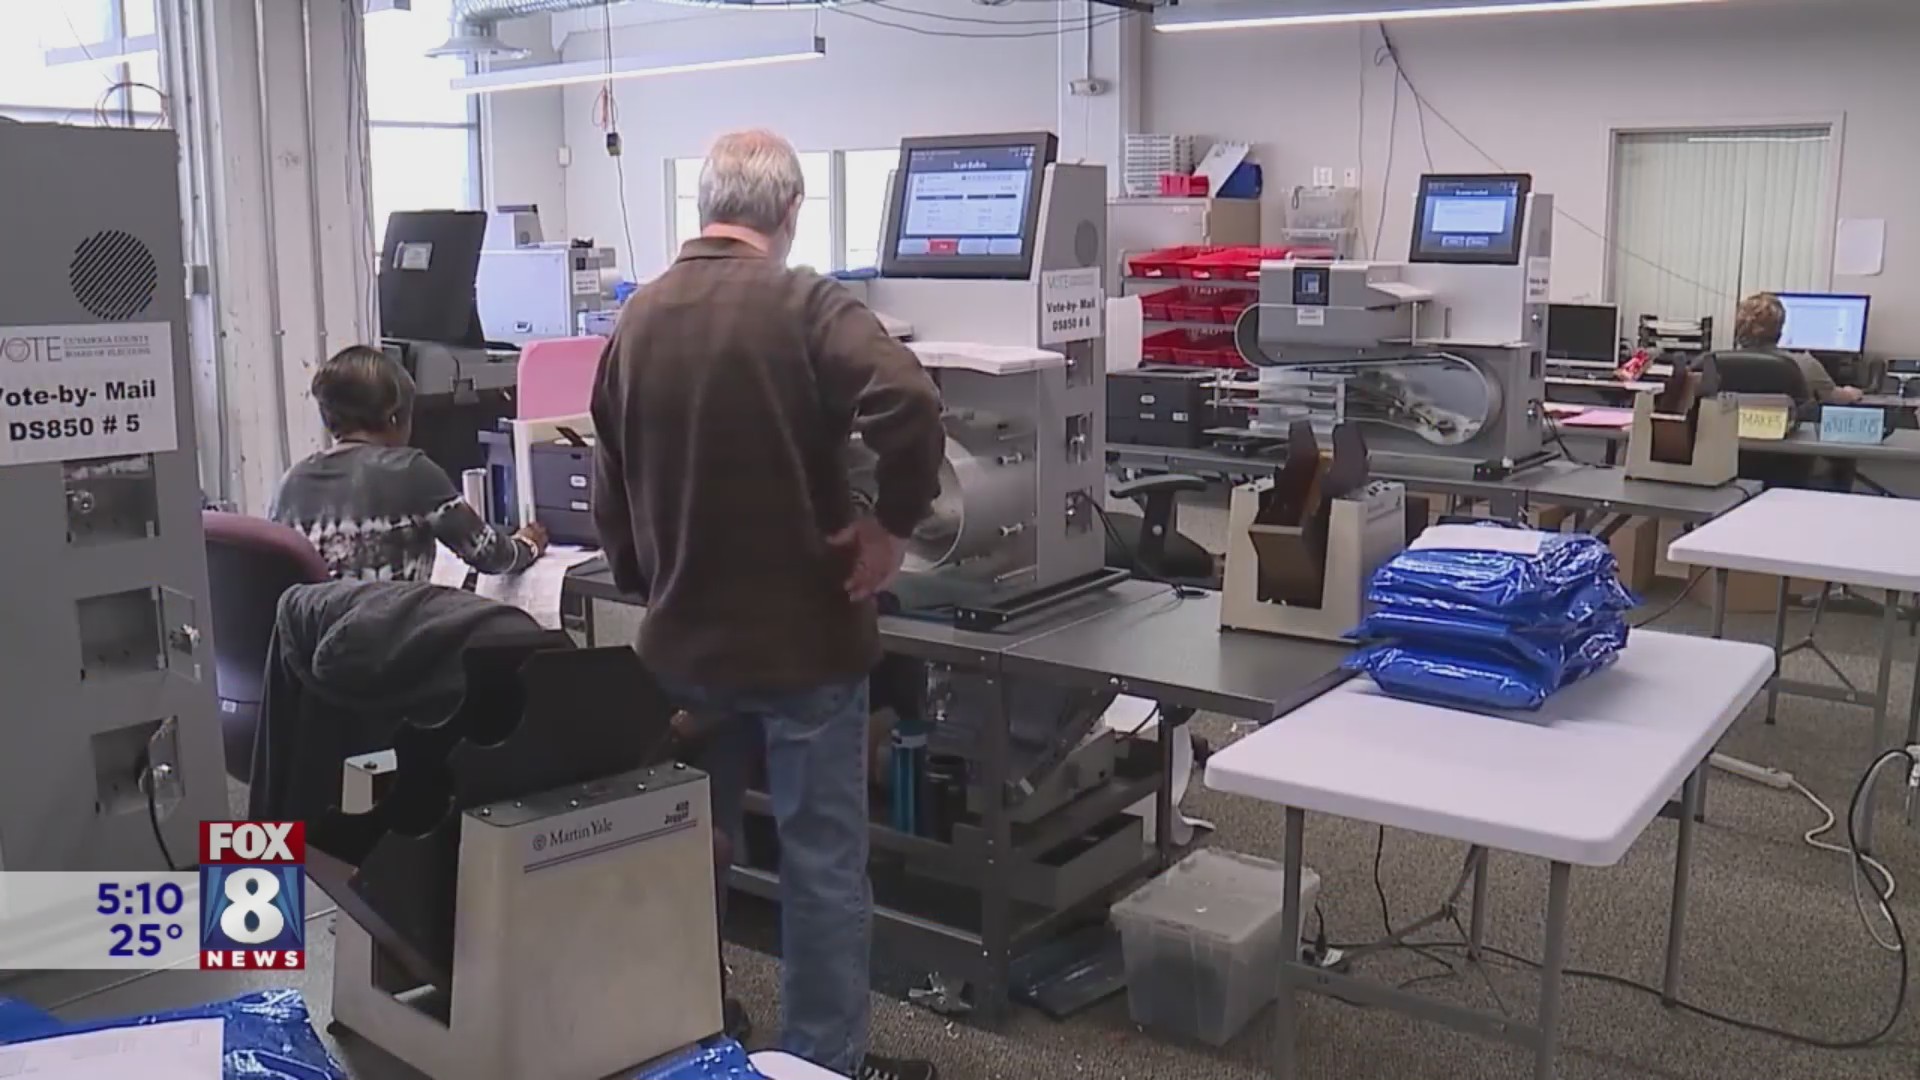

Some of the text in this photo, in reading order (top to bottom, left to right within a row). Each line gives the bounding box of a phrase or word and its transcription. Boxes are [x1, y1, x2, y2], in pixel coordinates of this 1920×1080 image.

[0, 379, 156, 407] ote-by- Mail
[9, 414, 140, 441] DS850 # 5
[550, 817, 612, 847] Martin Yale
